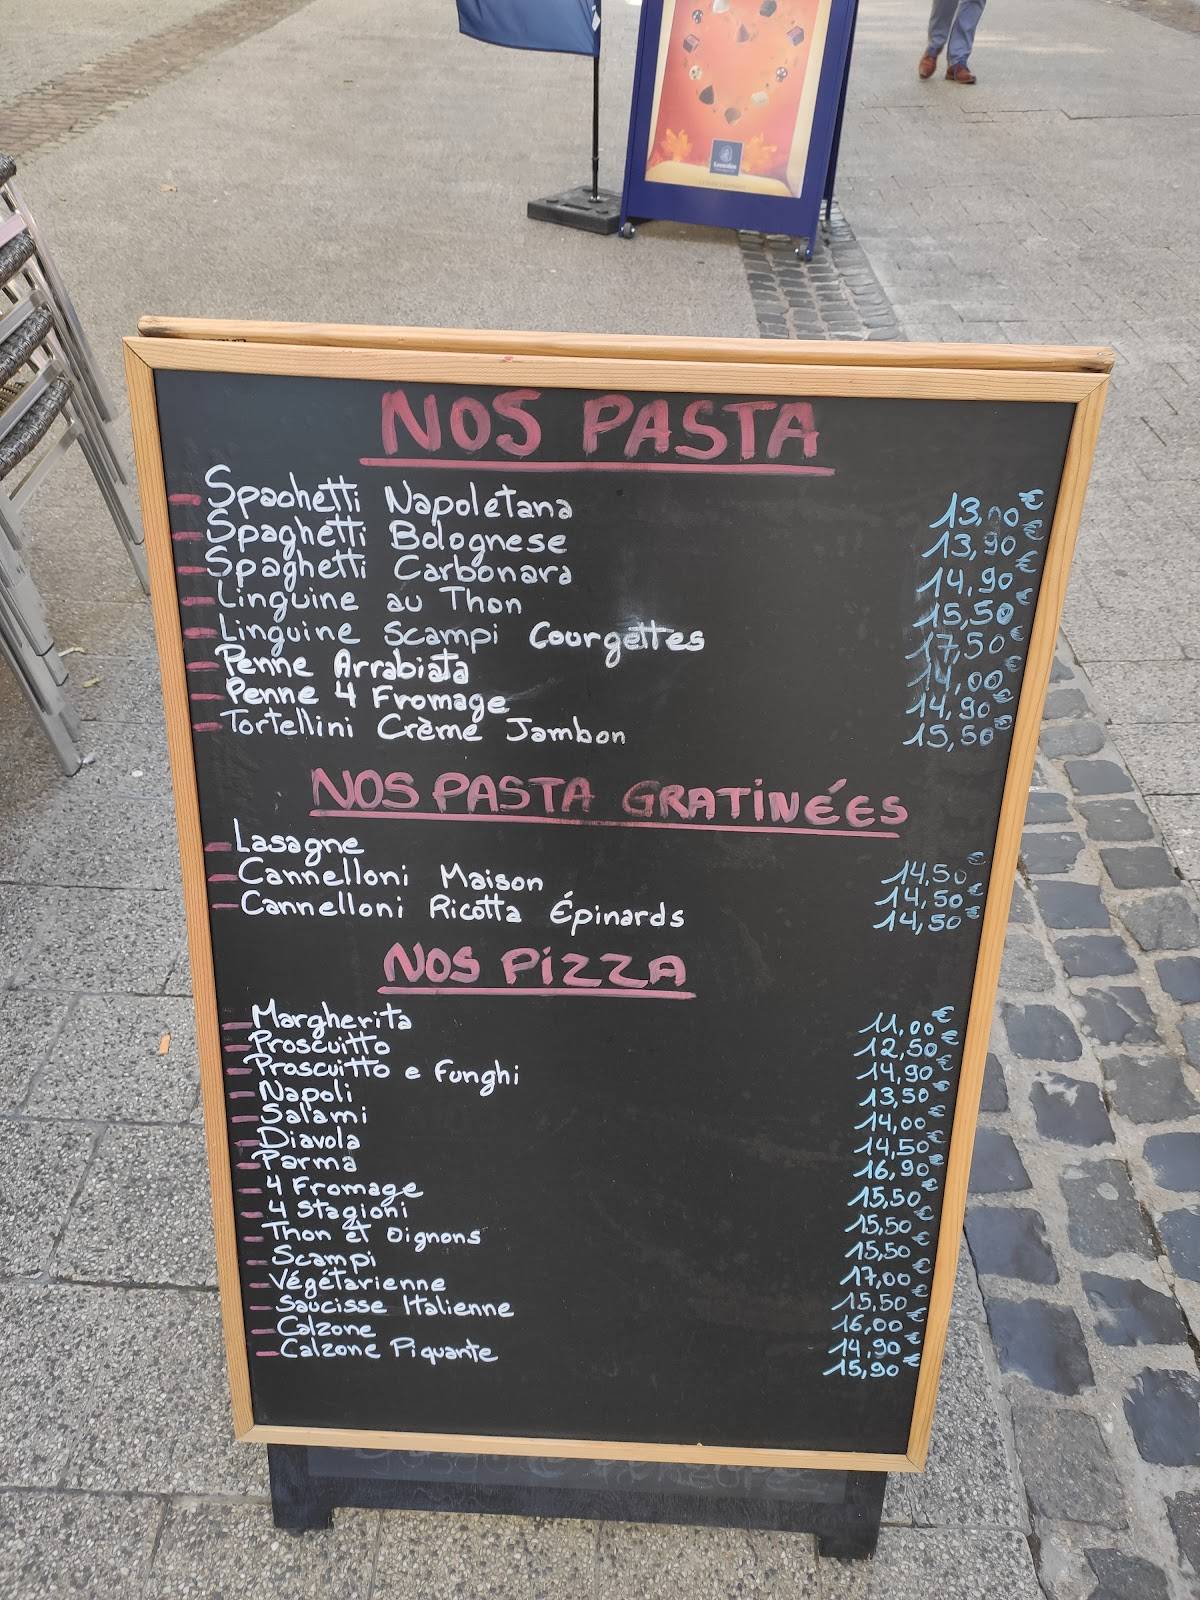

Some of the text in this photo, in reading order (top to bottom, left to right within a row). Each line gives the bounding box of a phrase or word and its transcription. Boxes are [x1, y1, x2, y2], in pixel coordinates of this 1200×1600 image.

[381, 388, 820, 461] NOS PASTA
[206, 508, 568, 565] Spaghetti Bolognese
[204, 546, 573, 592] Spaghetti Carbonara
[217, 579, 522, 623] Linguine au Thon
[218, 612, 706, 669] Linguine Scampi Courgettes
[214, 643, 470, 685] Penne Arrabiata
[225, 676, 511, 724] Penne 4 Fromage
[218, 706, 627, 745] Tortellini Crème Jambon
[311, 767, 420, 811] NOS
[433, 771, 596, 814] PASTA
[232, 817, 365, 867] Lasagne
[237, 856, 544, 892] Cannelloni Maison
[240, 889, 686, 937] Cannelloni Ricotta Épinards
[383, 941, 481, 984] NOS
[251, 997, 413, 1040] Margherita
[247, 1029, 391, 1056] Proscuitto
[242, 1052, 520, 1097] Proscuitto e Funghi
[258, 1078, 353, 1112] Napoli
[260, 1101, 368, 1124] Salami
[256, 1126, 361, 1149] Diavola
[250, 1149, 358, 1172] Parma
[266, 1174, 424, 1208] 4 Fromage
[268, 1198, 409, 1230] 4 Stagioni
[261, 1219, 482, 1253] Thon et Oignons
[271, 1244, 377, 1275] Scampi
[269, 1266, 447, 1300] Végétarienne
[275, 1294, 515, 1318] Saucisse Italienne
[276, 1314, 377, 1338] Calzone
[280, 1336, 499, 1366] Calzone Piquante
